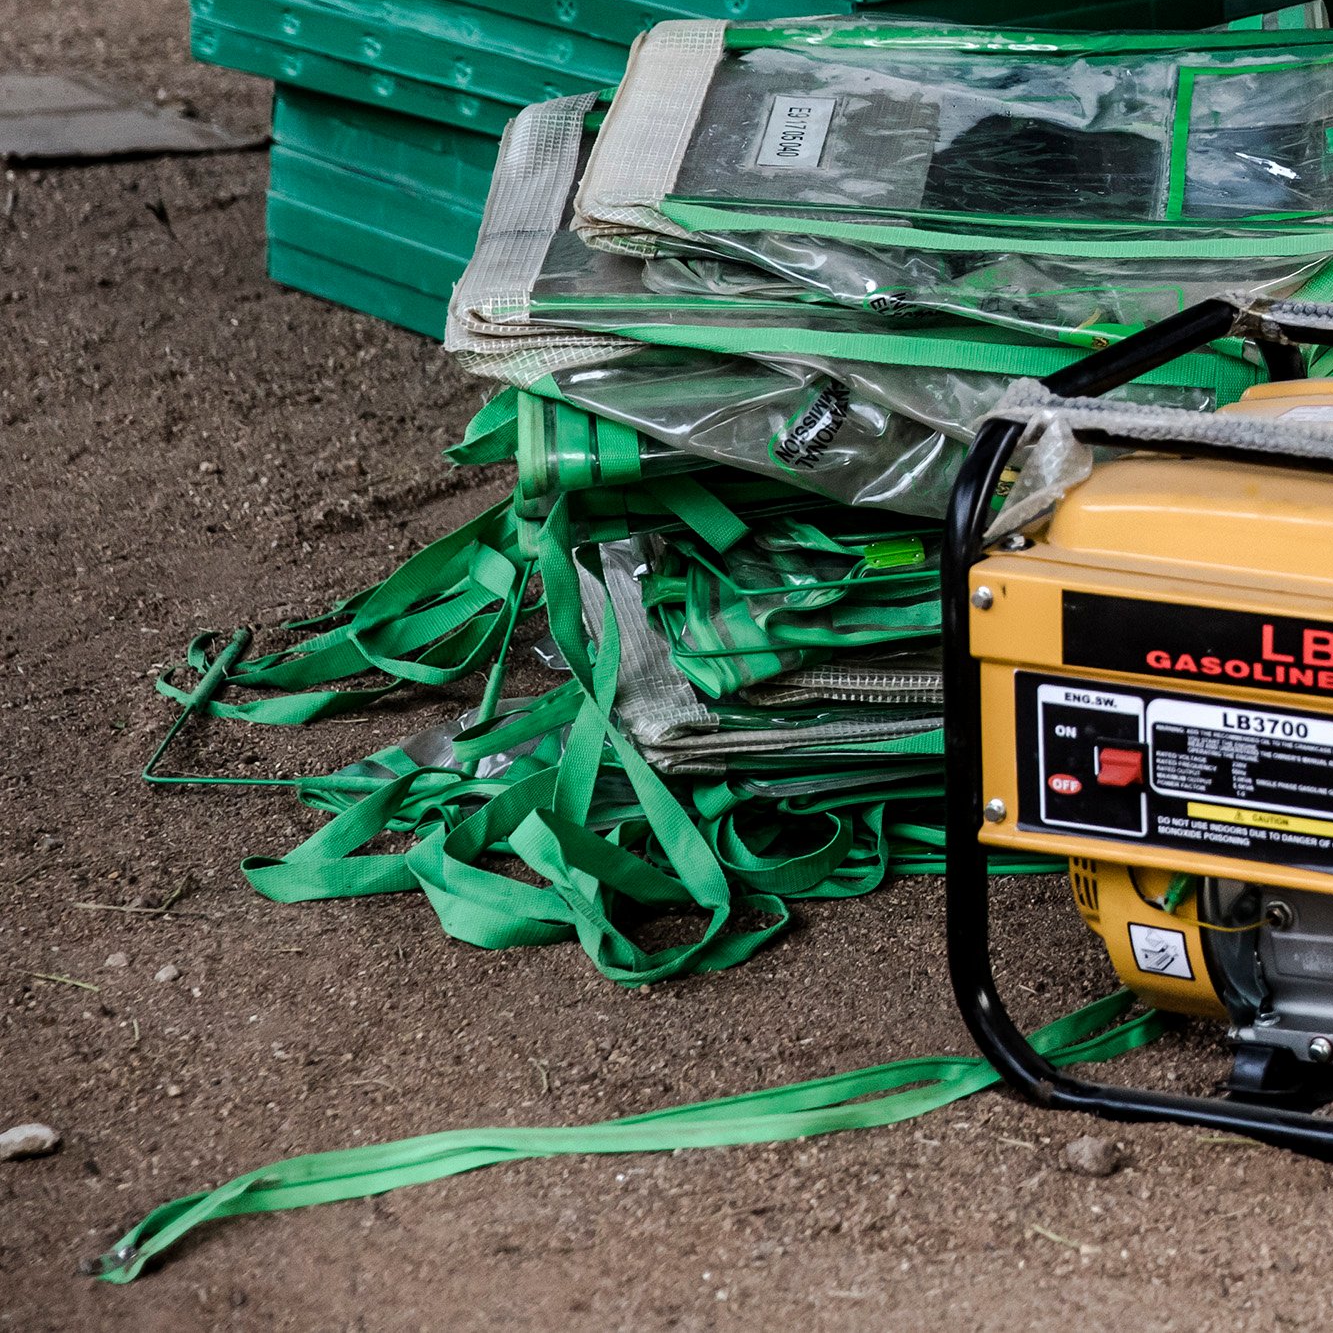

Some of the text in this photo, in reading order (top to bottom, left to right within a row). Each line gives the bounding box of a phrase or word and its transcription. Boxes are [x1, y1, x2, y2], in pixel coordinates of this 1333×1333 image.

[781, 131, 805, 141] 05
[776, 142, 802, 157] 040
[1064, 692, 1118, 708] ENG.SW.
[1054, 724, 1077, 739] ON
[1222, 712, 1309, 739] LB3700
[1052, 777, 1079, 792] OFF
[1252, 812, 1289, 827] CAUTION
[1157, 815, 1171, 825] DO
[1171, 817, 1189, 827] NOT
[1190, 820, 1208, 831] USE
[1209, 823, 1249, 836] INDOORS
[1249, 828, 1267, 839] DUE
[1269, 831, 1281, 841] TO
[1281, 833, 1318, 847] DANGER
[1319, 839, 1331, 849] OF
[1157, 825, 1250, 847] MONOXIDE POISONING
